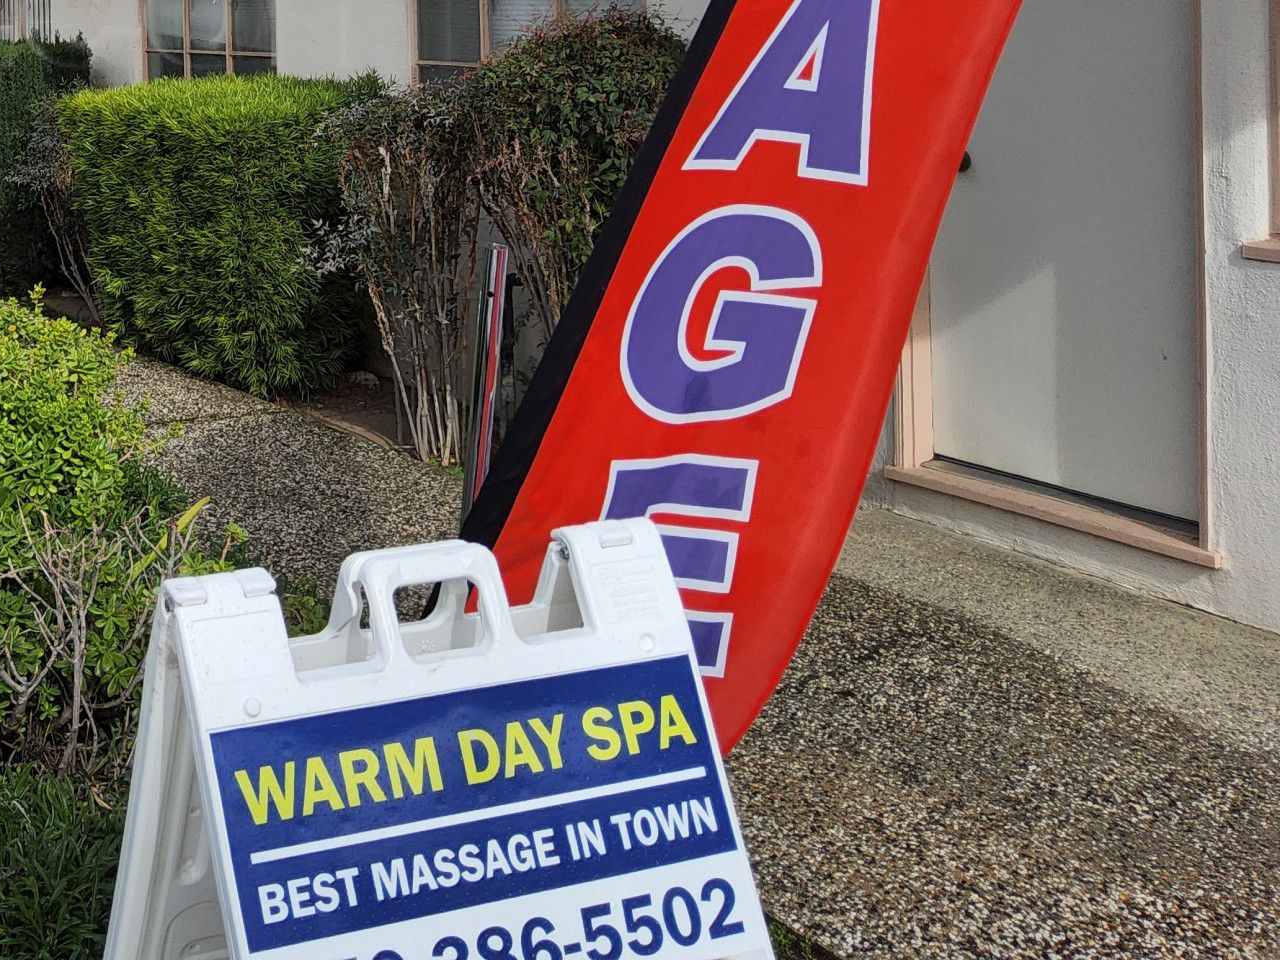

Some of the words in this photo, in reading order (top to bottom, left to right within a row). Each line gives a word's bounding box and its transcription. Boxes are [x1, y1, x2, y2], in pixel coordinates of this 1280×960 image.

[233, 735, 444, 825] WARM
[460, 713, 569, 786] DAY
[582, 693, 698, 763] SPA
[258, 865, 360, 925] BEST
[372, 827, 556, 897] MASSAGE
[565, 820, 607, 861] IN
[616, 795, 718, 849] TOWN
